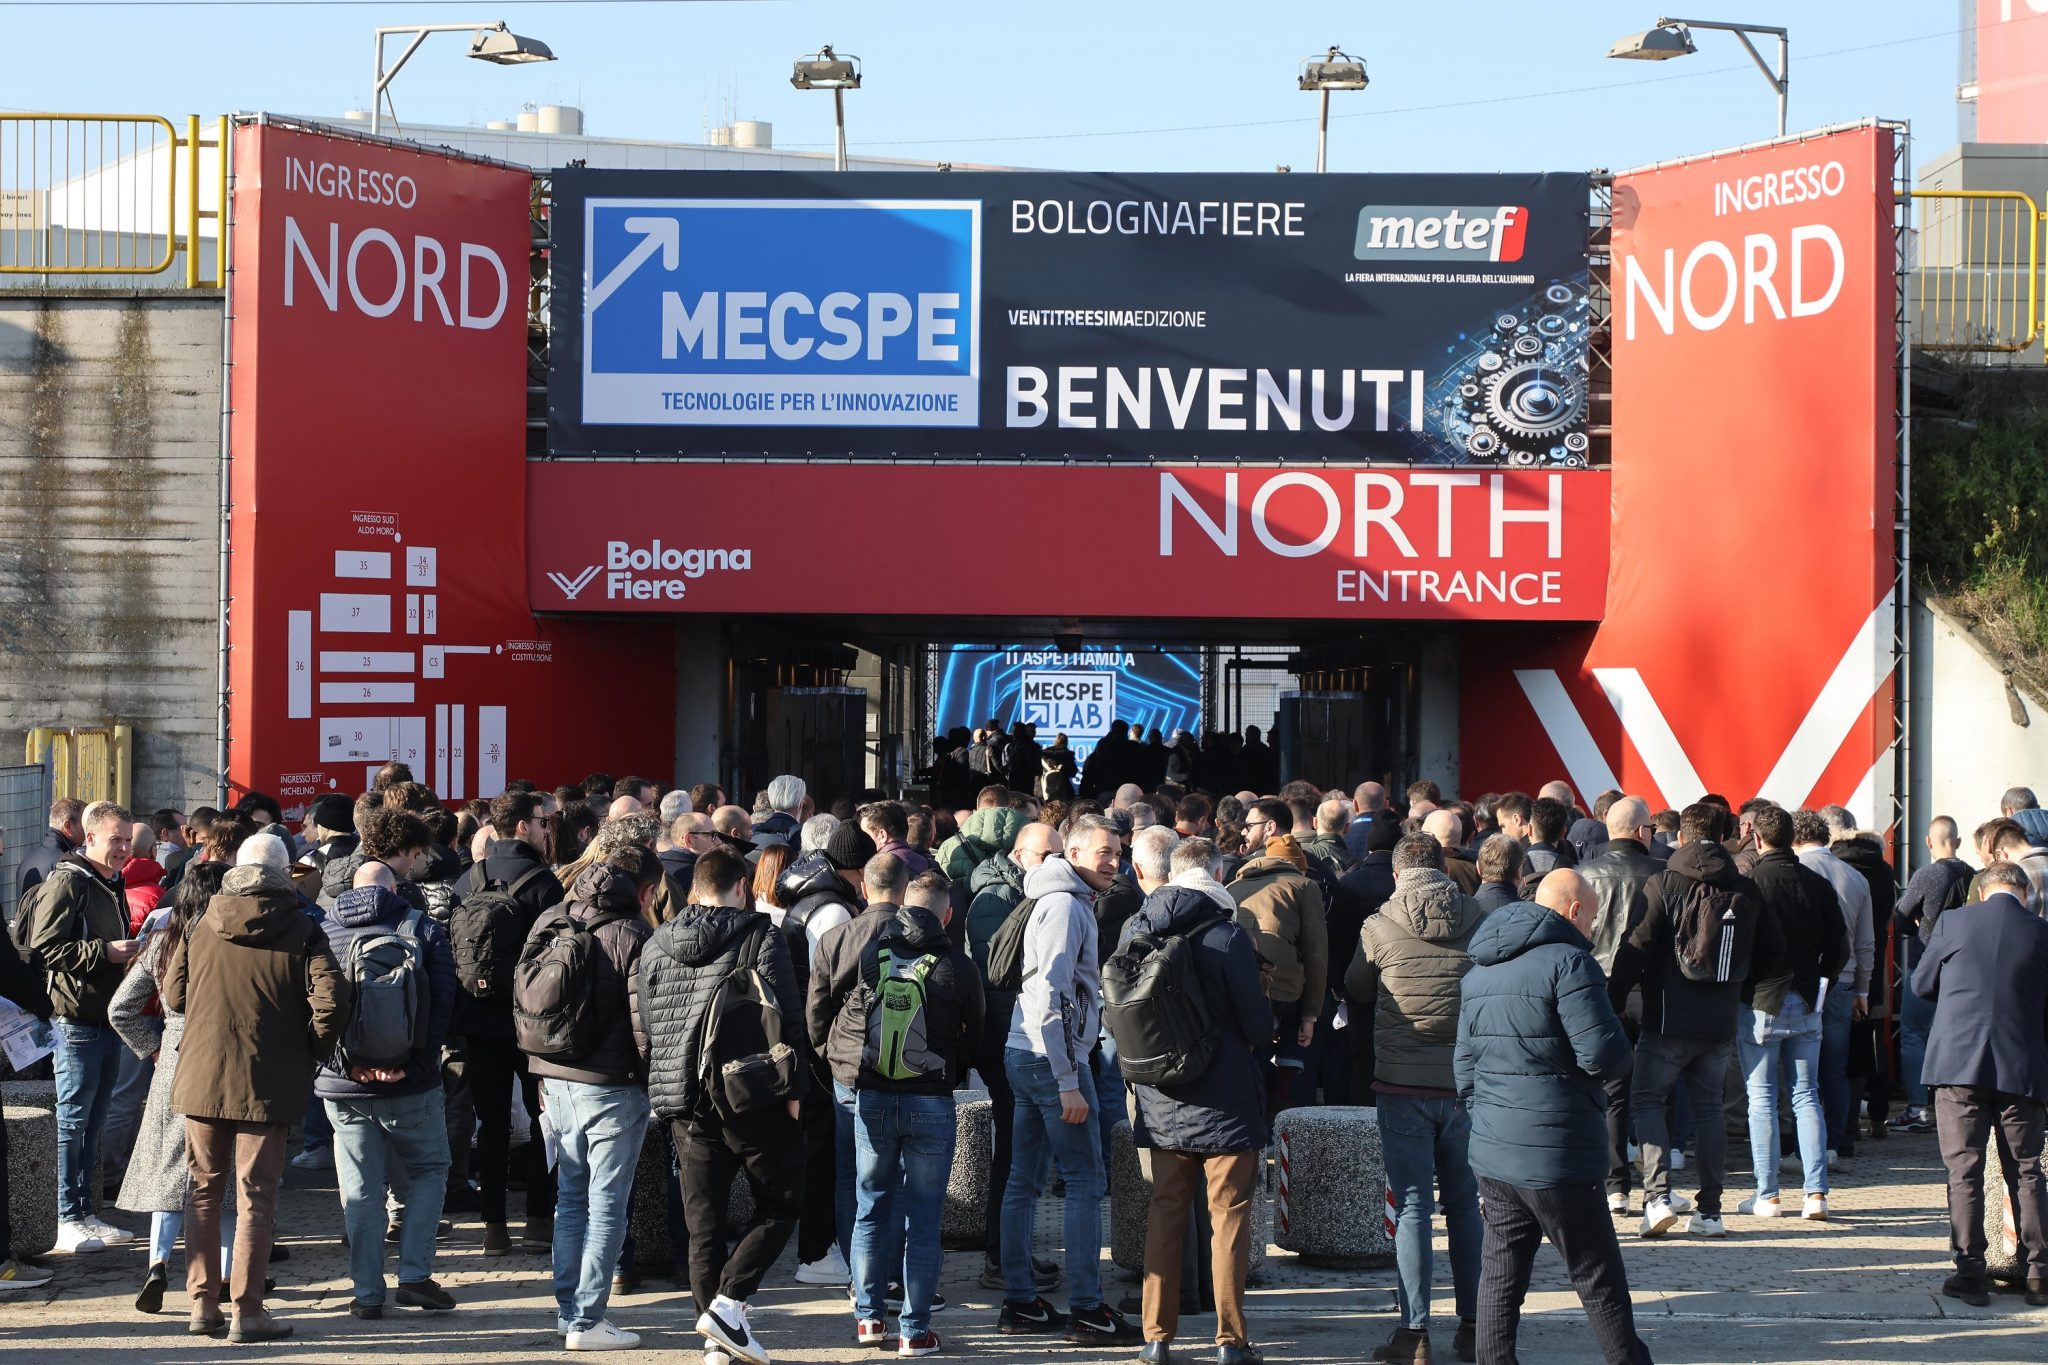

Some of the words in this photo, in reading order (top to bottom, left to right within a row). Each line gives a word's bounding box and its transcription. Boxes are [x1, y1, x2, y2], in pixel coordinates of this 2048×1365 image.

[285, 156, 417, 209] INGRESSO
[1714, 160, 1845, 216] INGRESSO
[1011, 199, 1306, 237] BOLOGNAFIERE
[1366, 205, 1520, 262] metef
[284, 216, 509, 330] NORD
[1345, 273, 1355, 282] LA
[1355, 273, 1375, 283] FIERA
[1375, 273, 1432, 283] INTERNAZIONALE
[1432, 274, 1446, 283] PER
[1446, 274, 1456, 283] LA
[1456, 274, 1482, 284] FILIERA
[1482, 274, 1535, 284] DELL'ALLUMINIO
[1624, 223, 1845, 341] NORD
[1008, 309, 1207, 329] VENTITREESIMAEDIZIONE
[661, 291, 961, 362] MECSPE
[661, 391, 775, 411] TECNOLOGIE
[780, 392, 815, 411] PER
[821, 392, 959, 412] L'INNOVAZIONE
[1006, 365, 1425, 432] BENVENUTI
[352, 513, 381, 523] INGRESSO
[382, 515, 395, 524] SUD
[1159, 471, 1563, 559] NORTH
[358, 526, 375, 535] ALDO
[376, 527, 395, 536] MORO
[418, 555, 427, 565] 34
[607, 538, 752, 578] Bologna
[360, 560, 368, 570] 35
[418, 567, 427, 576] 33
[607, 571, 686, 600] Fiere
[1336, 569, 1563, 605] ENTRANCE
[351, 607, 360, 617] 37
[408, 609, 417, 619] 32
[426, 609, 434, 619] 31
[507, 642, 535, 650] INGRESSO
[363, 656, 371, 667] 25
[428, 657, 439, 667] CS
[1124, 652, 1136, 667] A
[295, 661, 304, 671] 36
[362, 687, 371, 698] 26
[1024, 682, 1104, 701] MECSPE
[1054, 703, 1103, 729] LAB
[353, 731, 363, 741] 30
[408, 748, 417, 758] 29
[438, 748, 446, 758] 21
[454, 748, 462, 758] 22
[280, 774, 311, 784] INGRESSO
[311, 774, 322, 783] EST
[280, 786, 315, 796] MICHELINO
